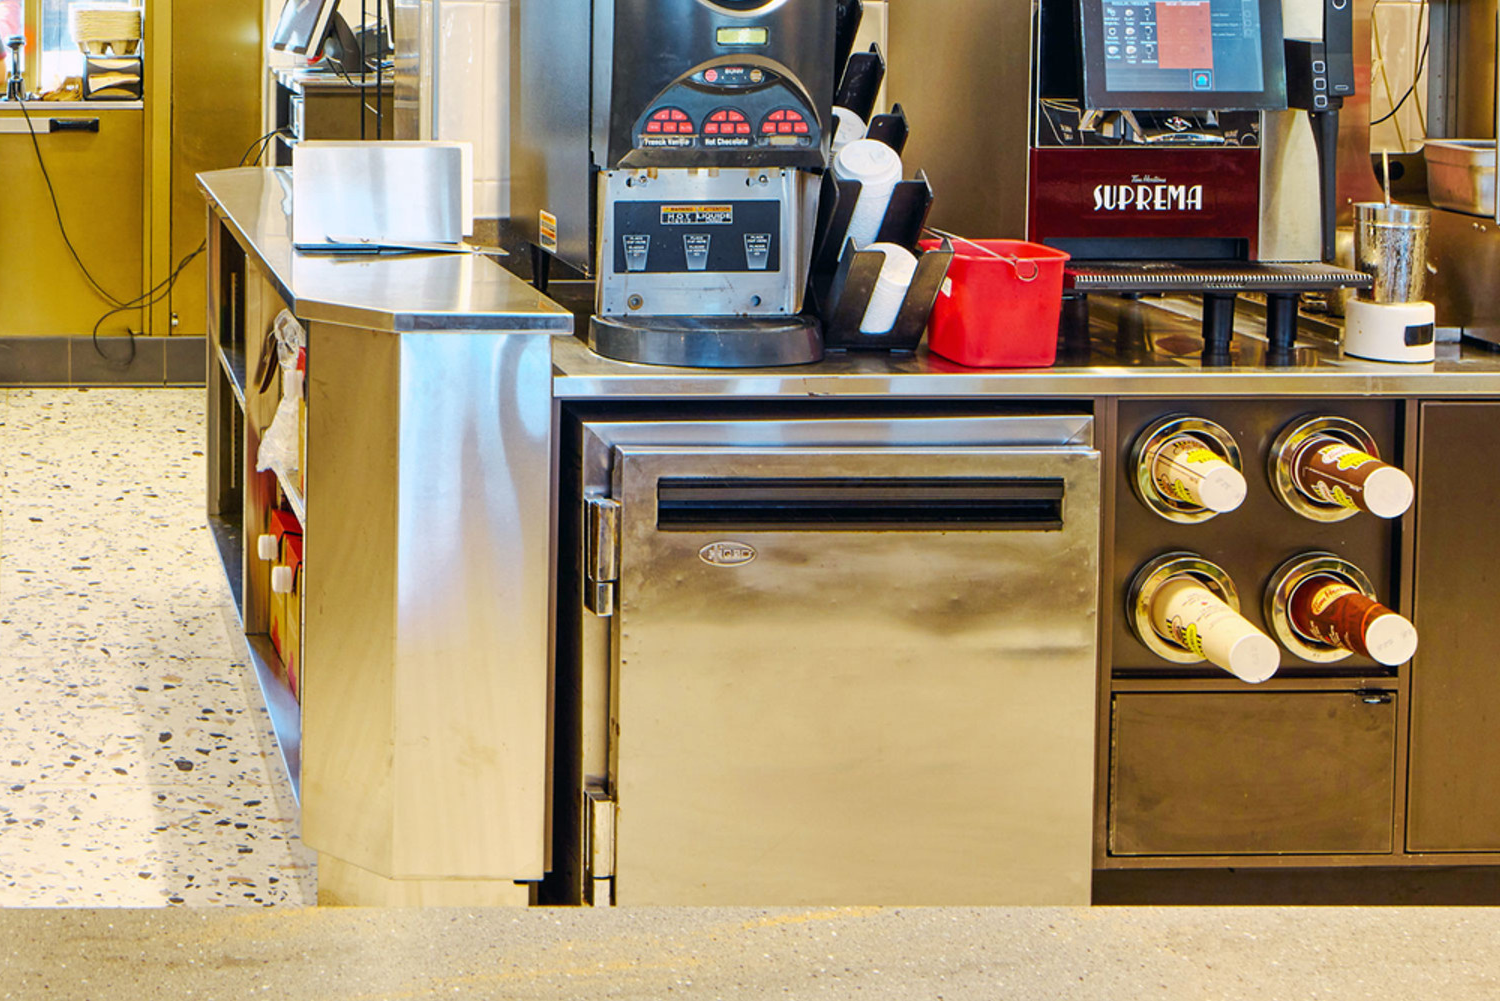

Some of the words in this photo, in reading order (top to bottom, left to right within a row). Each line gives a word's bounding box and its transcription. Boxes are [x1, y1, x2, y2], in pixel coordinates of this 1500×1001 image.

[705, 138, 716, 146] Hot
[717, 138, 748, 146] Chocolate
[1093, 184, 1203, 211] SUPREMA
